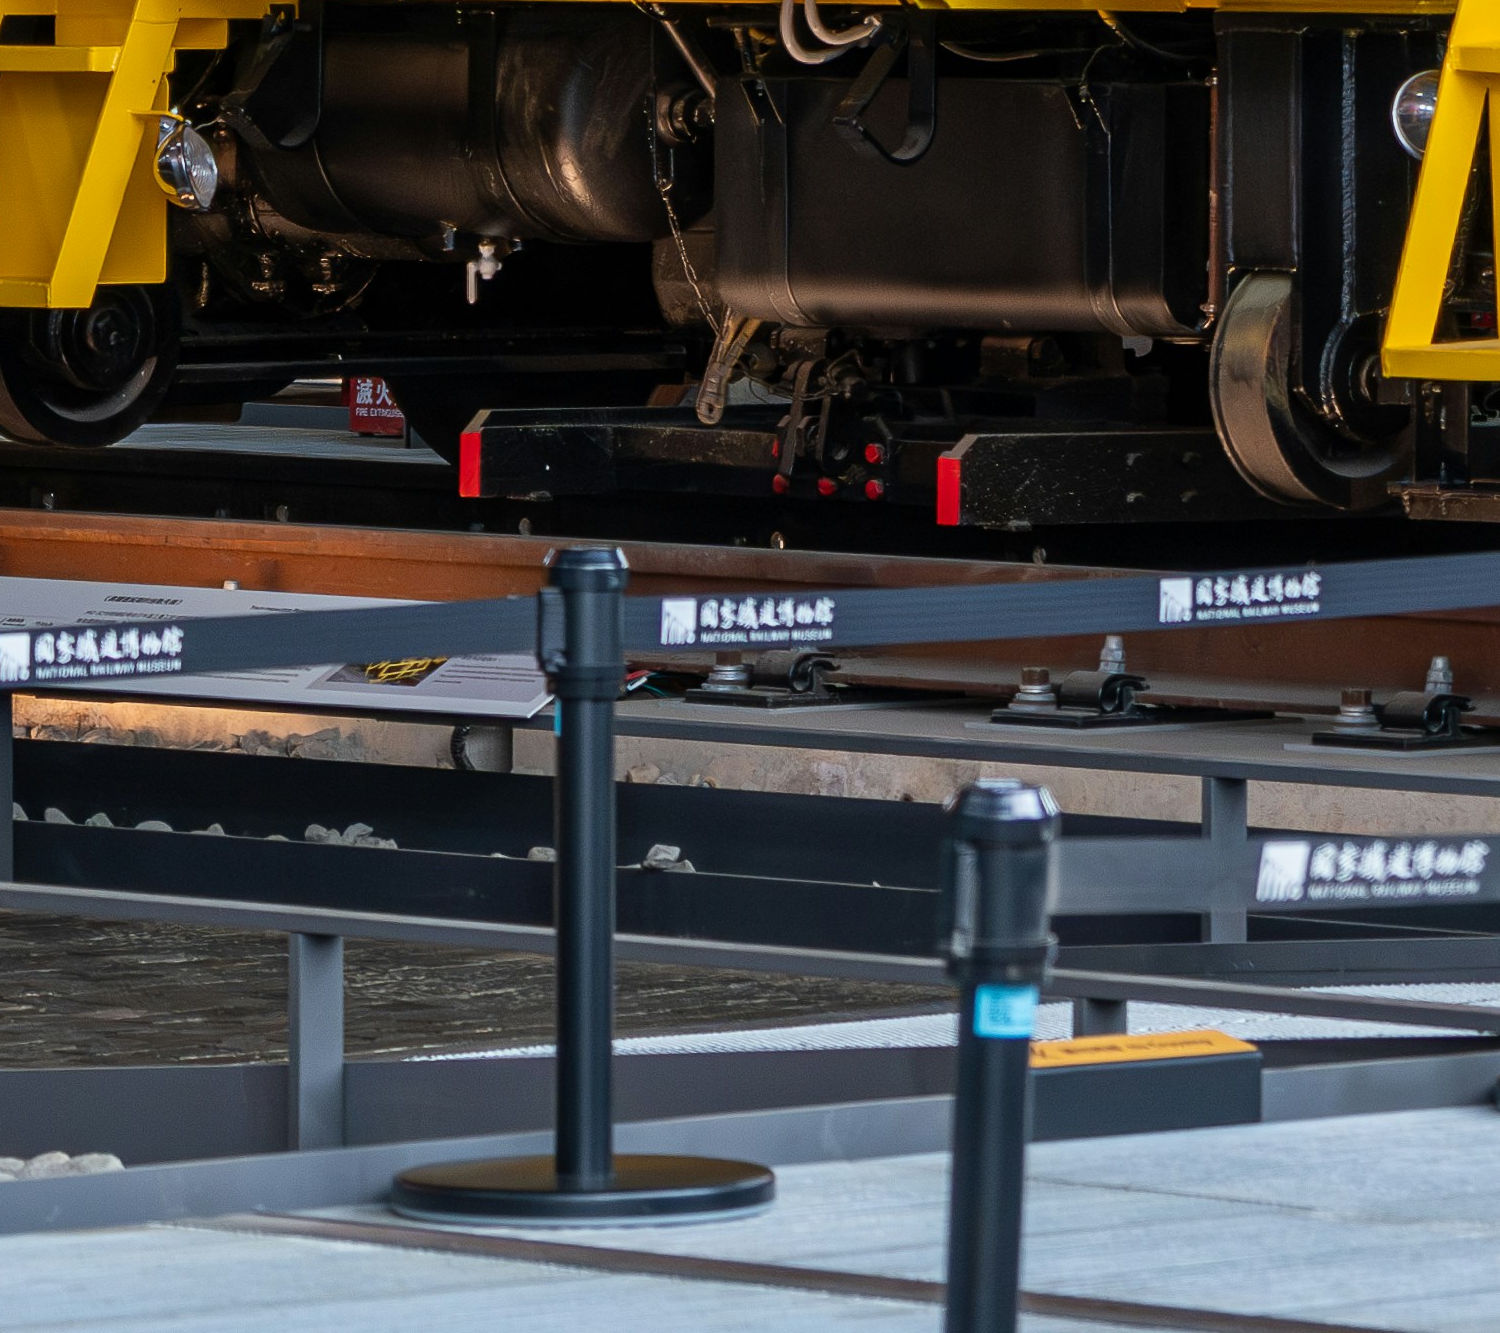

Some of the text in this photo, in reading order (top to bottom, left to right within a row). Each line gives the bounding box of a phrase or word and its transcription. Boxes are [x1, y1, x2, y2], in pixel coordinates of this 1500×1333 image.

[1196, 571, 1322, 606] 國家鐵道博物館
[700, 597, 835, 629] 國家鐵道博物館
[35, 626, 184, 664] 國家鐵道博物館
[1310, 839, 1490, 882] 國家鐵道博物館
